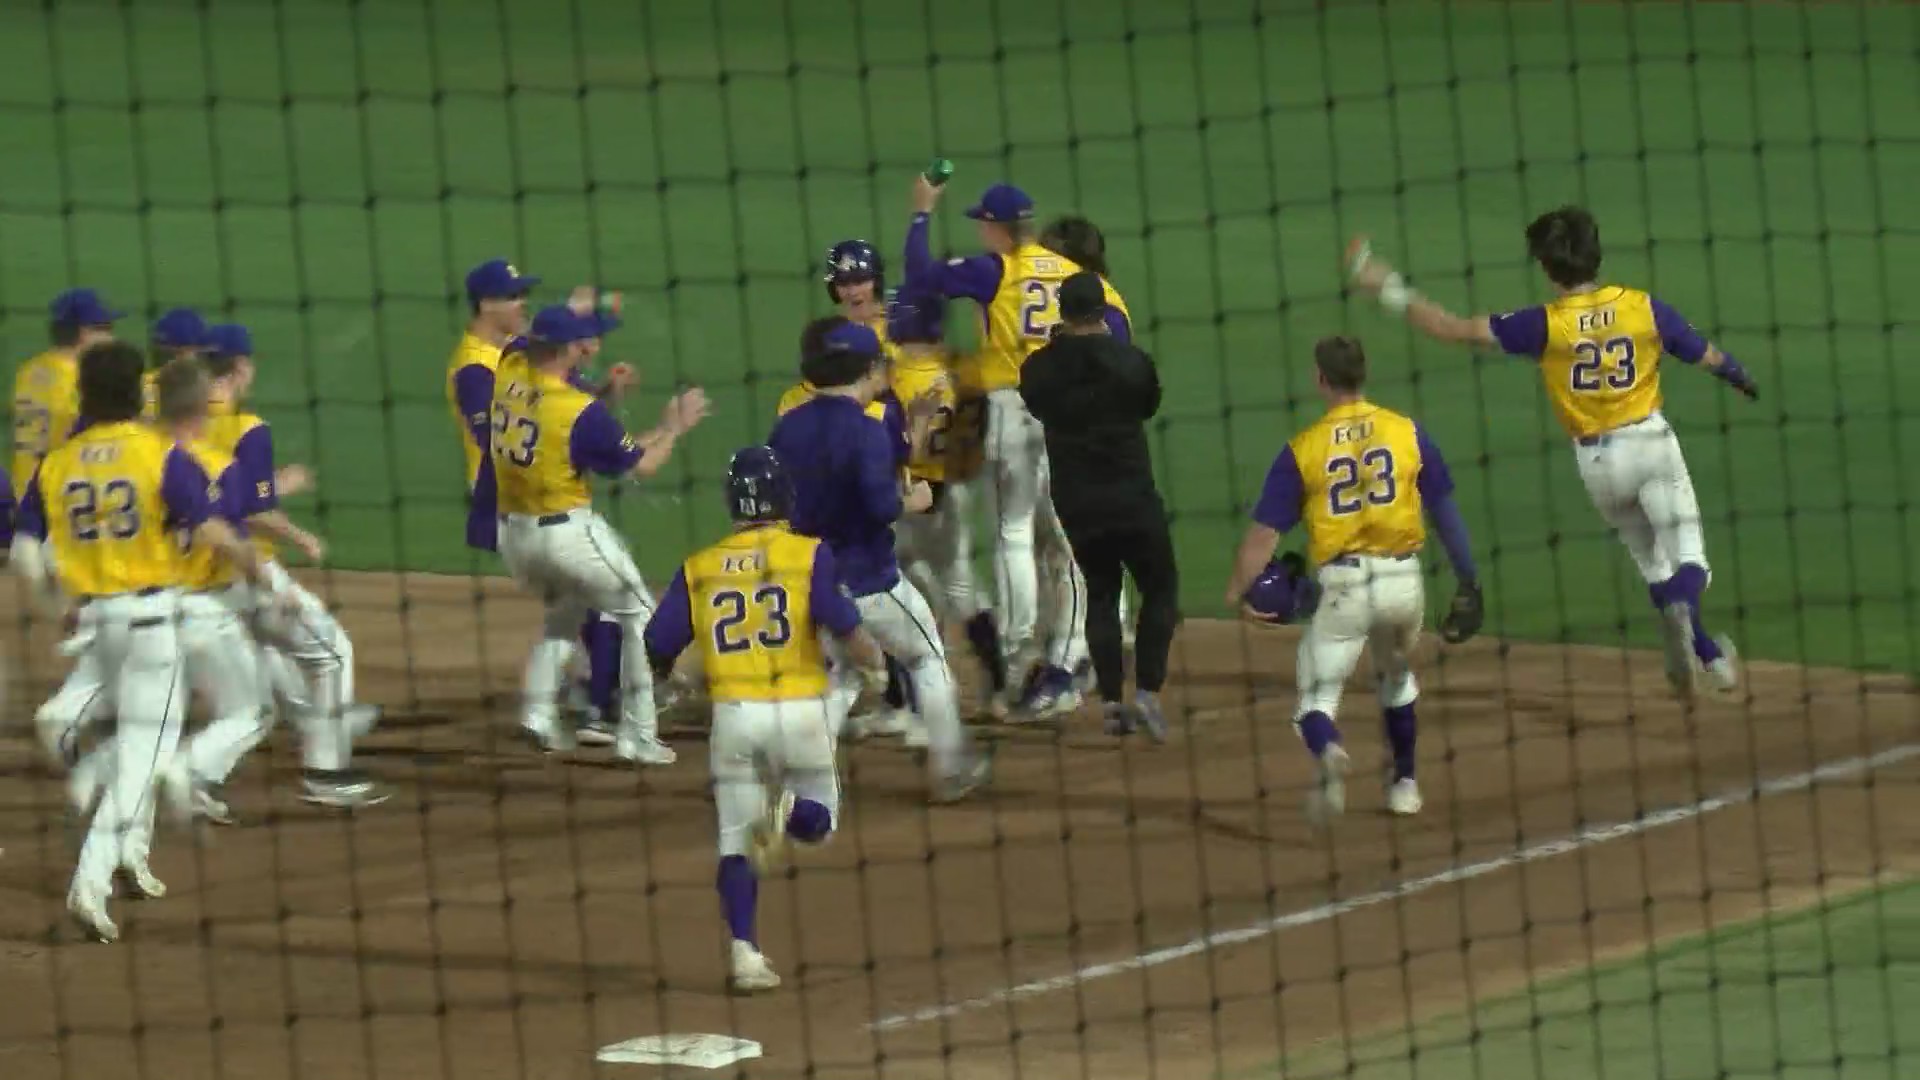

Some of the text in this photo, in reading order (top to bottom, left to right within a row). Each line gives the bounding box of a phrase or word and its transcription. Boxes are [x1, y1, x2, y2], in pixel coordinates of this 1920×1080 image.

[1578, 310, 1617, 332] ECU
[1571, 335, 1637, 392] 23
[1333, 421, 1375, 445] ECU
[64, 478, 140, 541] 23
[1326, 446, 1397, 516] 23
[712, 583, 792, 656] 23
